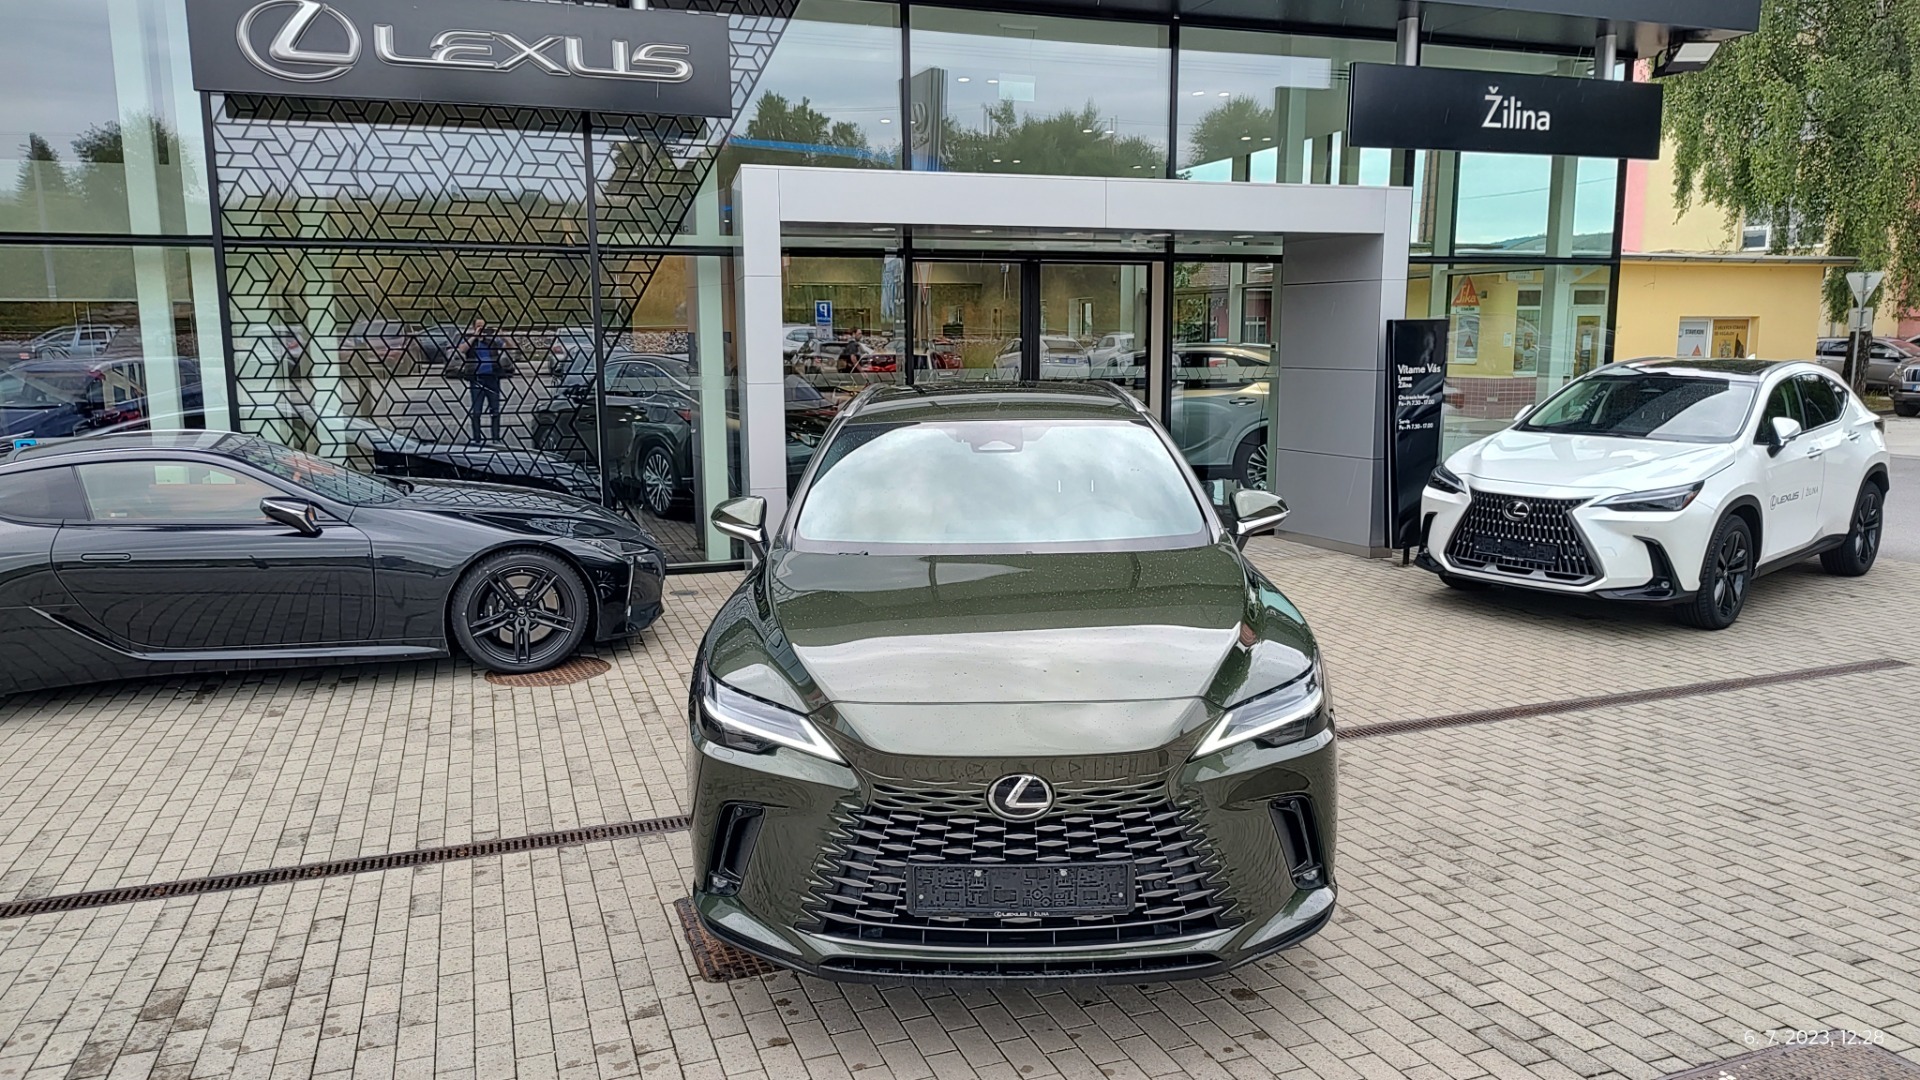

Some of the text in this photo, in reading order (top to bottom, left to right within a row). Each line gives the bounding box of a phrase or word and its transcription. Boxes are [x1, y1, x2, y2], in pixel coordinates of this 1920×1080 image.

[373, 23, 694, 83] LEXUS
[1481, 86, 1551, 131] Žilina
[1426, 363, 1441, 373] Vás
[1775, 491, 1800, 505] LEXUS
